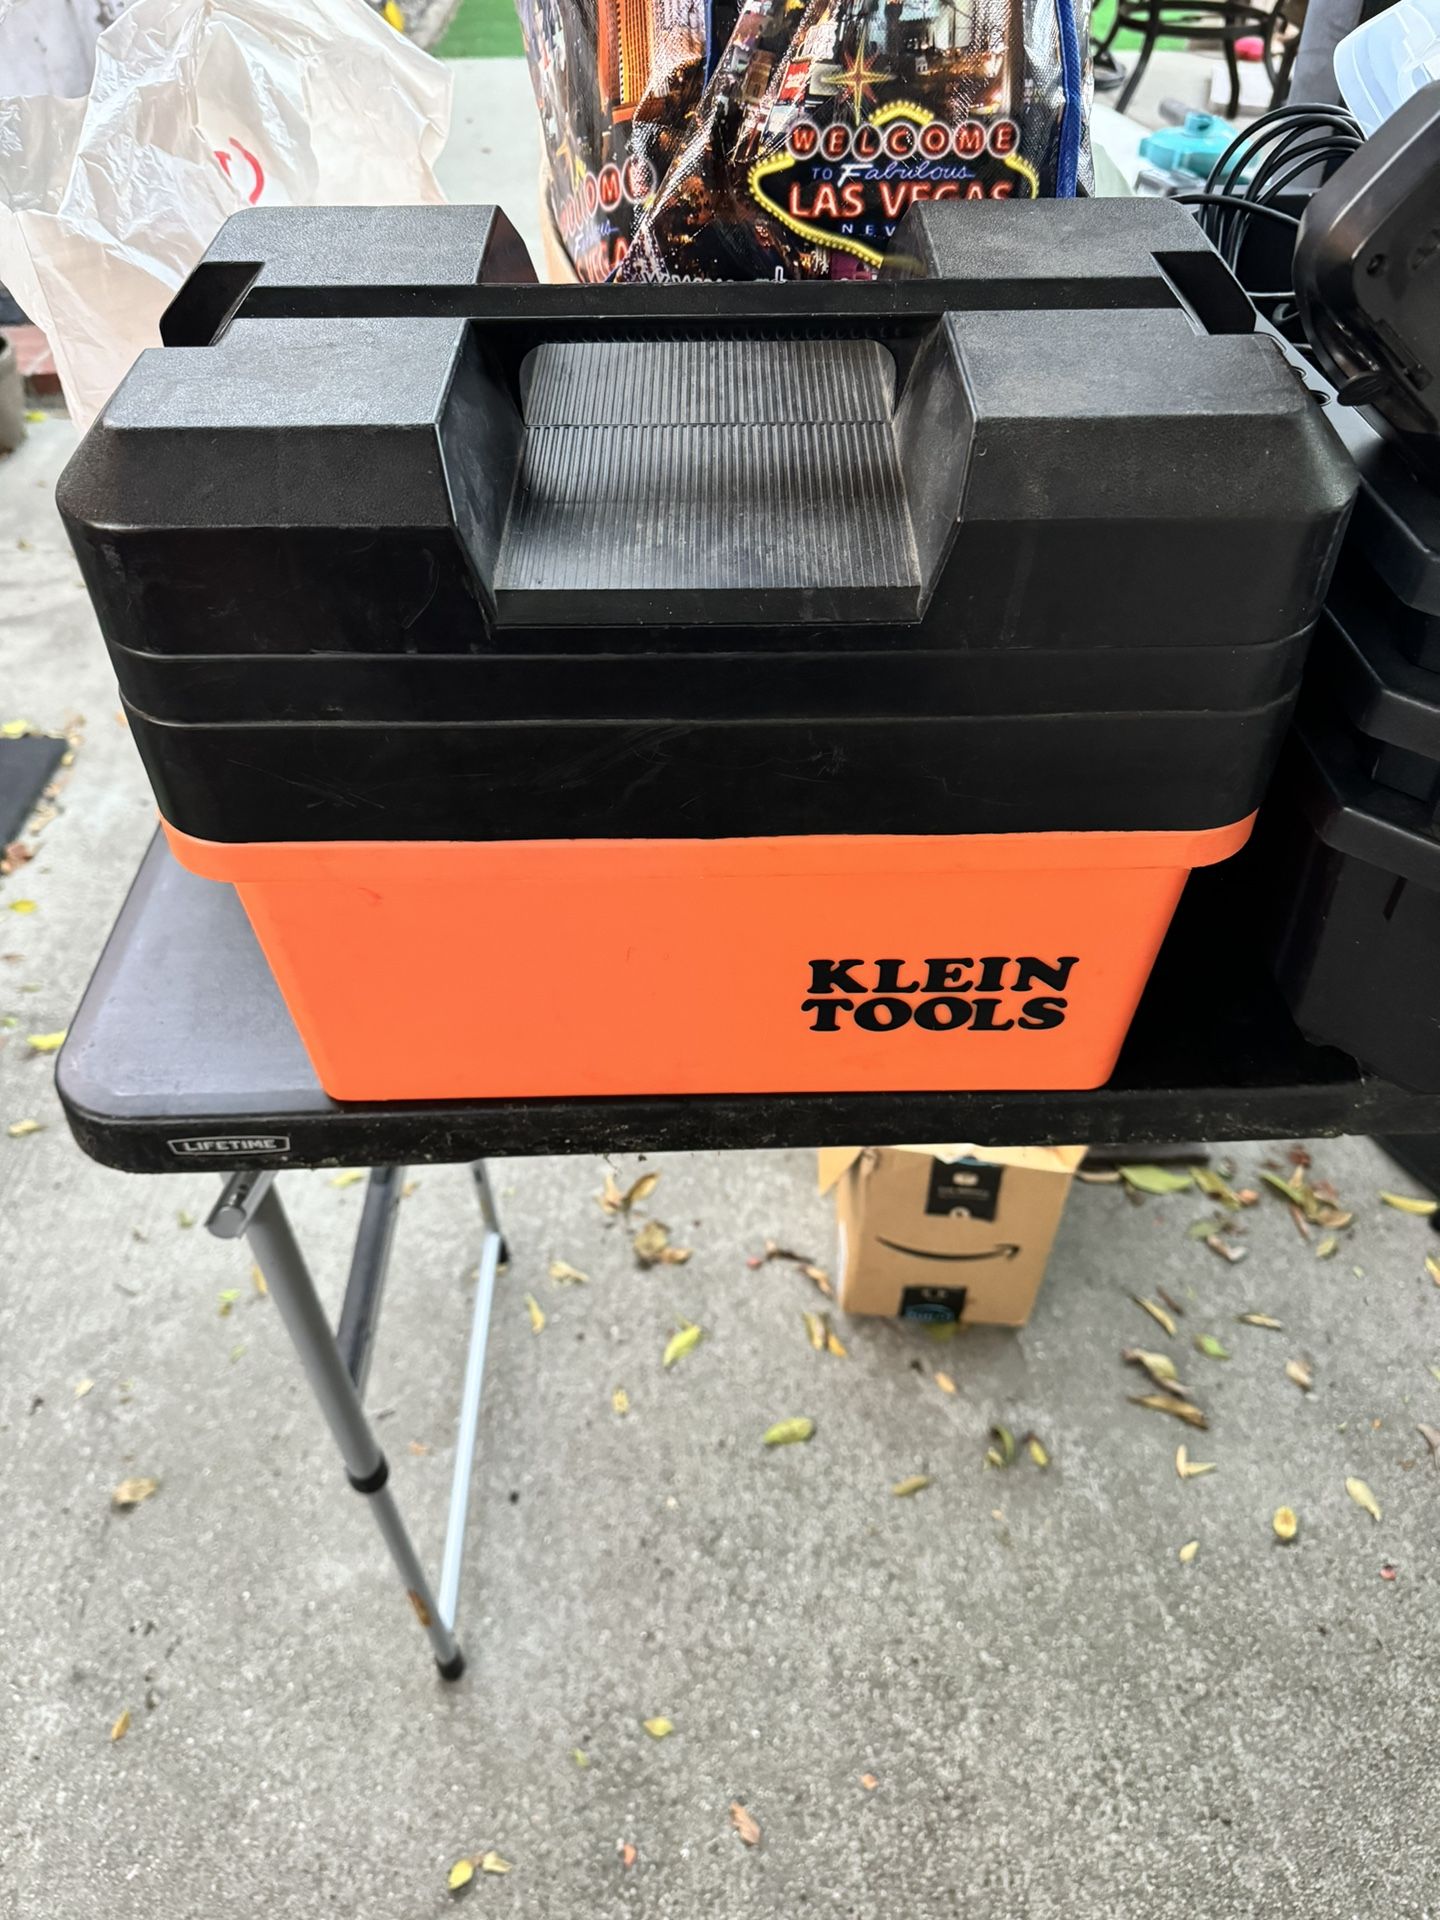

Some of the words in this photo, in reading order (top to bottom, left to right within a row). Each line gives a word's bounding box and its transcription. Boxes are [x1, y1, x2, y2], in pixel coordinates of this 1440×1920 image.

[790, 123, 1014, 154] WELCOME
[812, 168, 833, 180] TO
[837, 161, 975, 187] Fabulous
[789, 182, 865, 218] LAS
[806, 956, 1080, 994] KLEIN
[800, 996, 1068, 1032] TOOLS
[183, 1139, 277, 1151] LIFETIME
